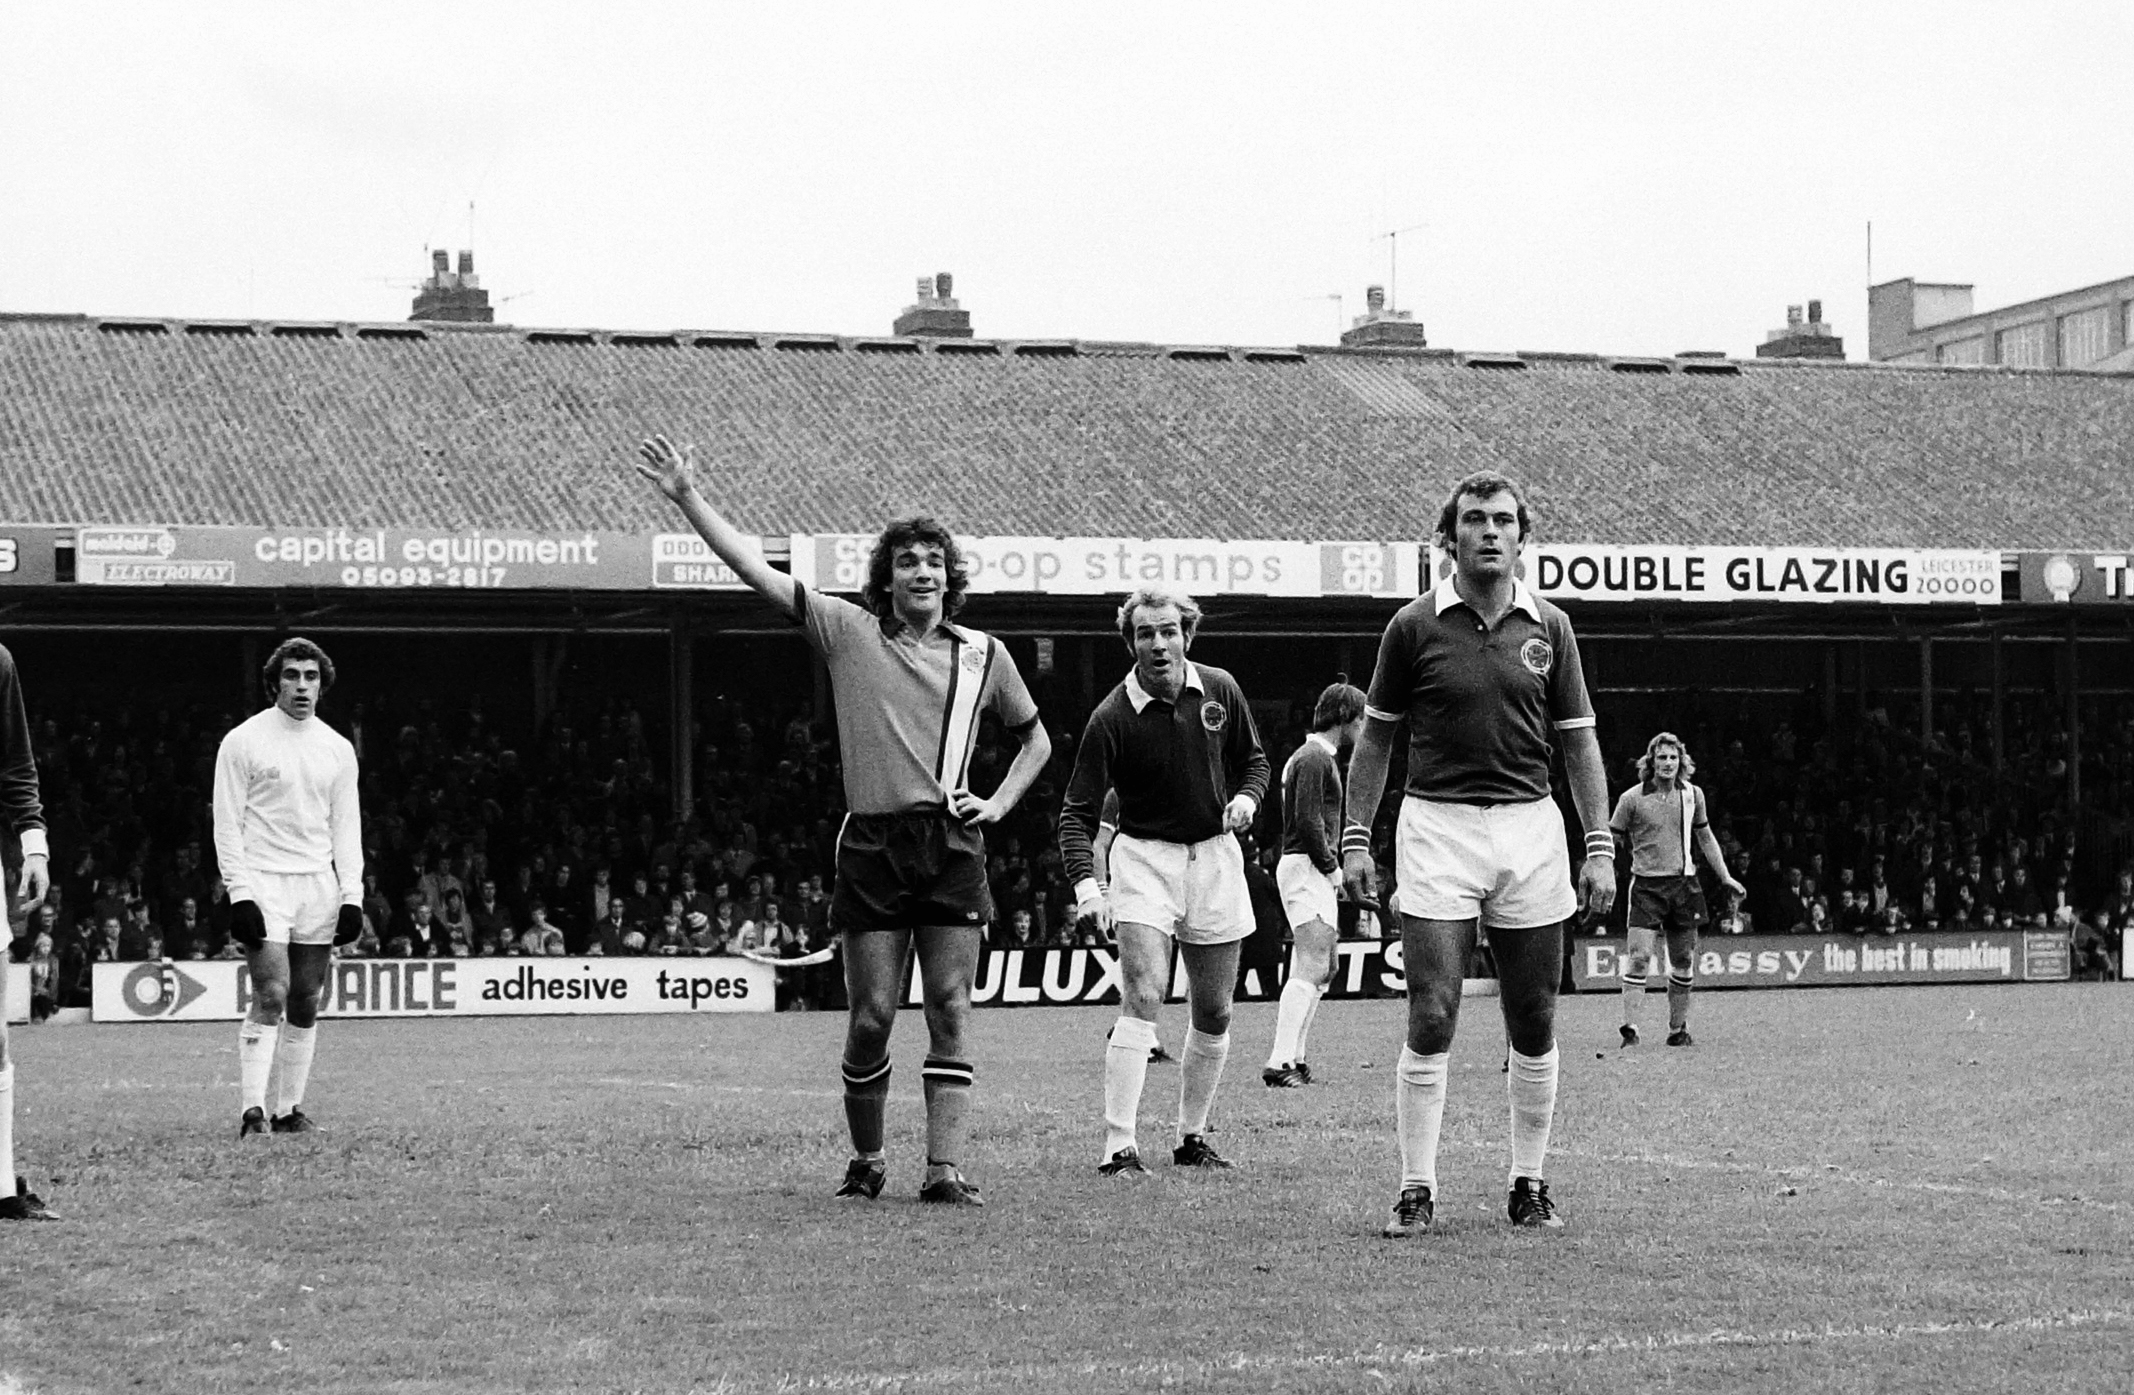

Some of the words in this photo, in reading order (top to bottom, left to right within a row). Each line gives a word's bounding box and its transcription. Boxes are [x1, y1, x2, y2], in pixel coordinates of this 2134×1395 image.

[254, 530, 386, 567] capital
[402, 531, 599, 568] equipment
[962, 550, 1061, 591] o-op
[1084, 543, 1283, 591] stamps
[1538, 556, 1706, 591] DOUBLE
[1725, 557, 1908, 594] GLAZING
[909, 948, 1124, 1004] ULUX
[1586, 945, 1813, 981] Eassy
[236, 962, 457, 1013] AANCE
[481, 965, 628, 1001] adhesive
[656, 970, 750, 1010] tapes
